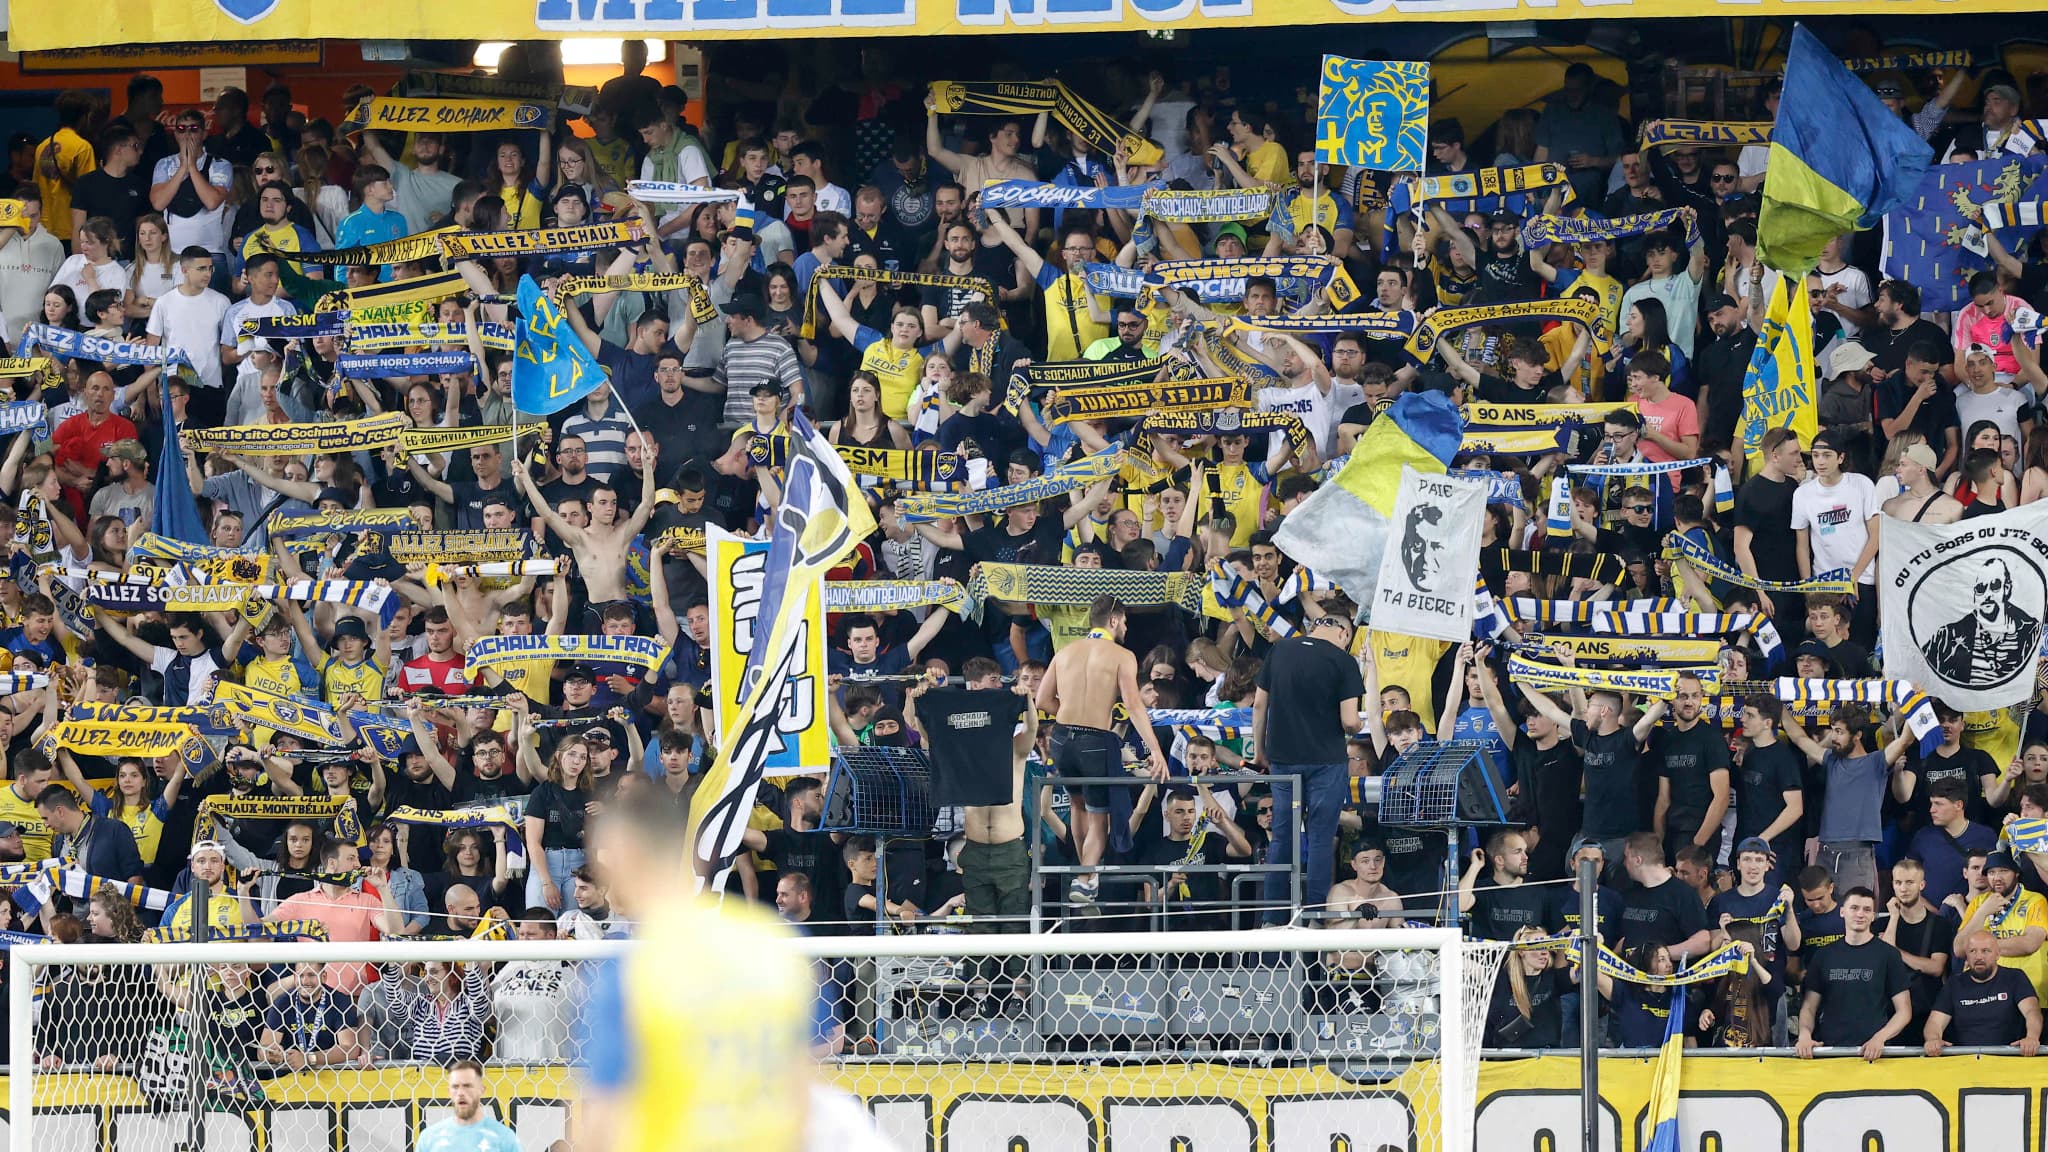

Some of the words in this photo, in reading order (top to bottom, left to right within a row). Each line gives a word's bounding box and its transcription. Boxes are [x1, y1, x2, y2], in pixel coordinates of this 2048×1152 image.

[379, 106, 430, 123] ALLEZ
[435, 106, 505, 126] SOCHAUX
[985, 186, 1096, 202] SOCHAUX
[470, 233, 530, 250] ALLEZ
[547, 226, 619, 246] SOCHAUX
[361, 300, 425, 320] NANTES
[271, 314, 317, 327] FCSM
[381, 357, 411, 368] NORD
[412, 355, 464, 367] SOCHAUX
[1029, 369, 1042, 380] FC
[1043, 365, 1091, 382] SOCHAUX
[1477, 408, 1499, 421] 90
[1502, 407, 1536, 421] ANS
[200, 430, 228, 441] Tout
[229, 429, 243, 440] le
[244, 428, 271, 440] site
[271, 427, 288, 438] de
[290, 425, 347, 438] Sochaux
[318, 437, 350, 449] avec
[351, 434, 367, 446] le
[838, 449, 889, 468] CSM
[1418, 479, 1454, 498] PAIE
[1817, 509, 1852, 524] TOMMY
[390, 534, 441, 551] ALLEZ
[444, 533, 520, 551] SOCHAUX
[1894, 566, 1911, 589] OU
[1909, 550, 1932, 568] TU
[1934, 531, 1975, 554] SORS
[1978, 527, 1996, 538] OU
[2000, 527, 2031, 541] J'TE
[2031, 537, 2048, 557] SO
[88, 584, 141, 603] ALLEZ
[146, 585, 249, 604] SOCHAUX
[1382, 588, 1404, 606] TA
[1407, 594, 1456, 618] BIERE
[465, 635, 549, 668] SOCHAUX
[587, 634, 664, 656] ULTRAS
[1575, 641, 1610, 655] ANS
[253, 676, 293, 694] NEDEY
[950, 712, 989, 724] SOCHAUX
[953, 721, 985, 732] TECHNO
[61, 726, 112, 745] ALLEZ
[118, 729, 184, 754] SOCHAUX
[413, 807, 444, 819] ANS
